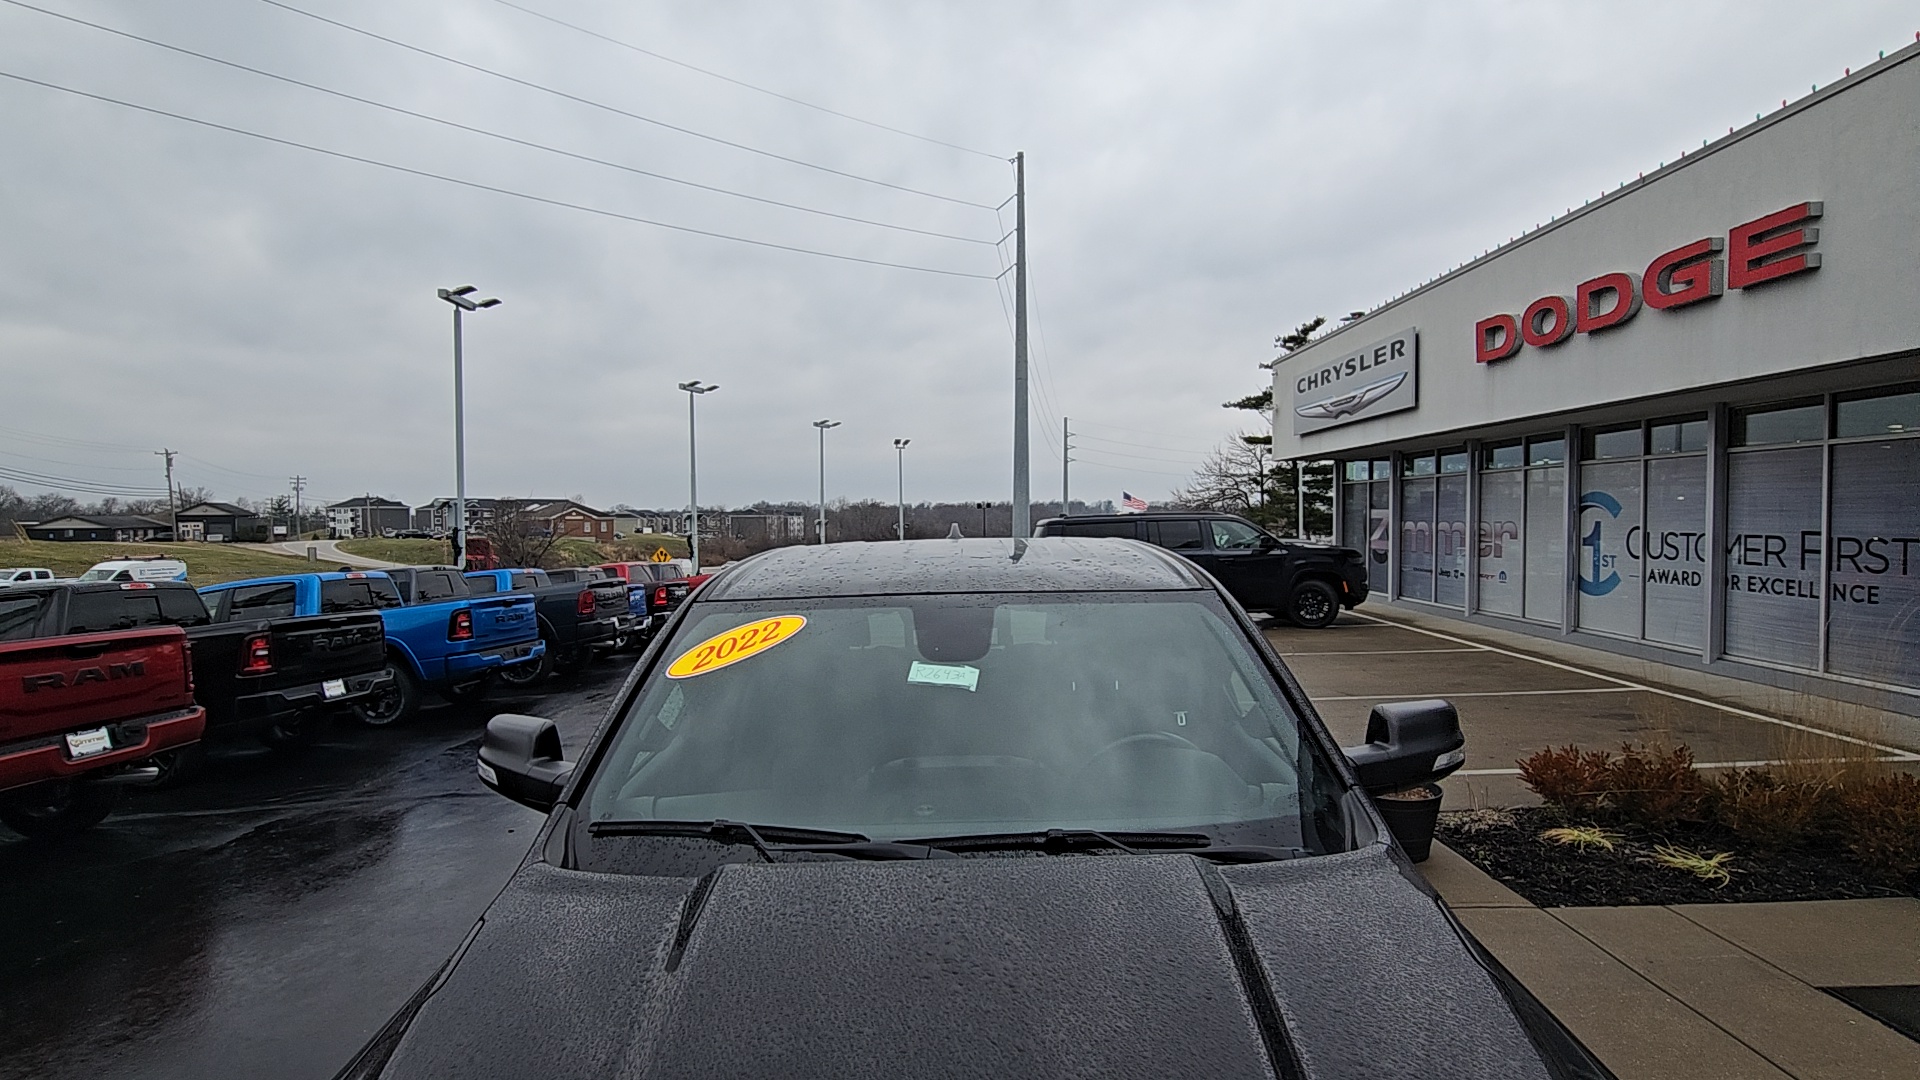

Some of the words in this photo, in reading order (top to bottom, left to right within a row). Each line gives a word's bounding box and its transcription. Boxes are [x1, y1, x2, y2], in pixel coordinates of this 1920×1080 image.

[1475, 203, 1823, 364] DODGE
[1297, 339, 1405, 394] CHRYSLER
[1370, 509, 1518, 559] Zmmer
[1647, 568, 1702, 587] AWARD
[1747, 575, 1880, 605] EXCELLNCE
[692, 621, 782, 671] 2022
[22, 661, 146, 693] RAM
